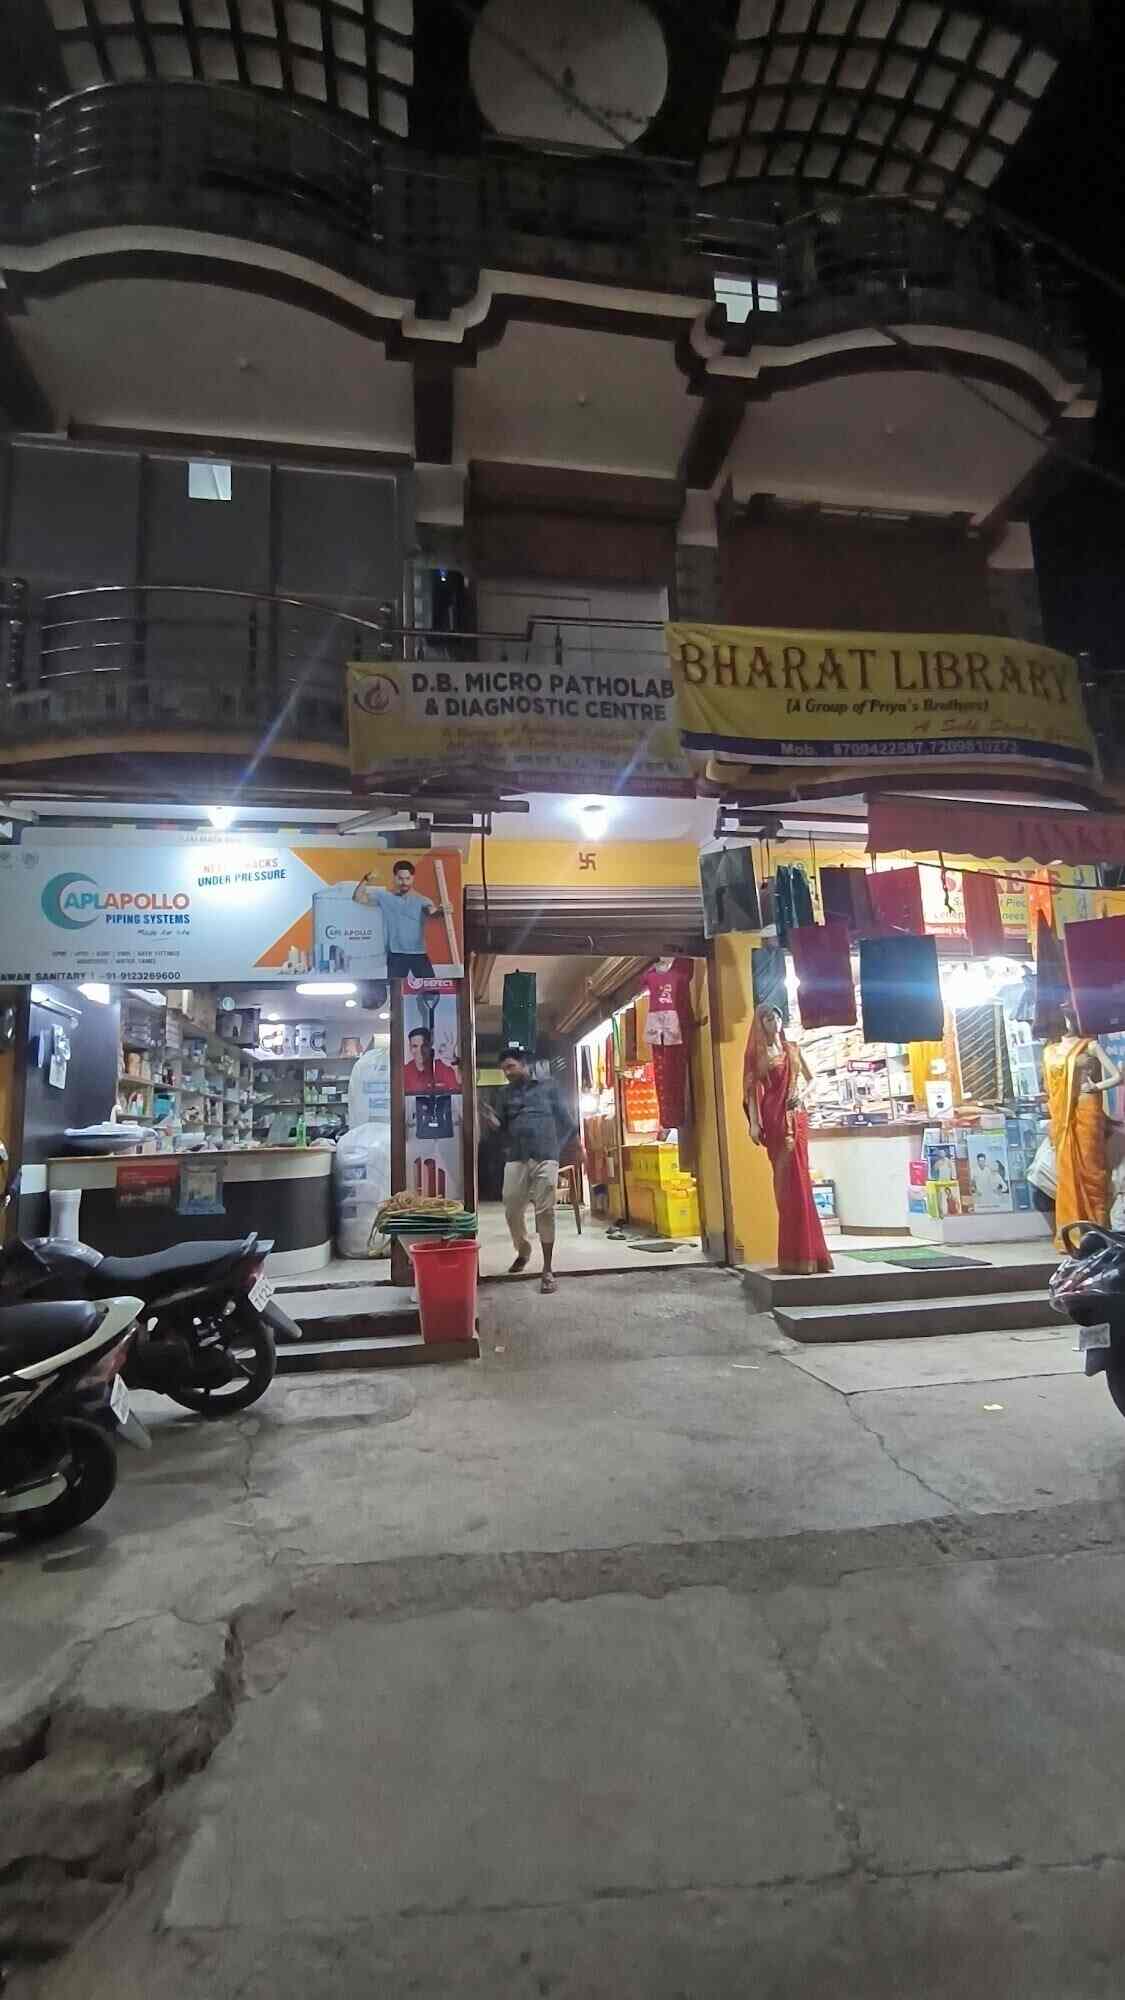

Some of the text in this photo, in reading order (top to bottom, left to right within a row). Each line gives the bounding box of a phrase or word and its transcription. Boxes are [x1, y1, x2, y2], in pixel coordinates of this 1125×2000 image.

[680, 643, 1072, 705] BHARAT LIBRARY
[412, 673, 675, 699] D.B. MICRO PATHOLAB
[424, 697, 666, 721] & DIAGNOSTIC CENTRE
[805, 698, 848, 714] Group
[851, 698, 866, 714] of
[198, 869, 287, 887] UNDER PRESSURE
[106, 914, 190, 925] PIPING SYSTEMS
[35, 971, 86, 982] SANITARY
